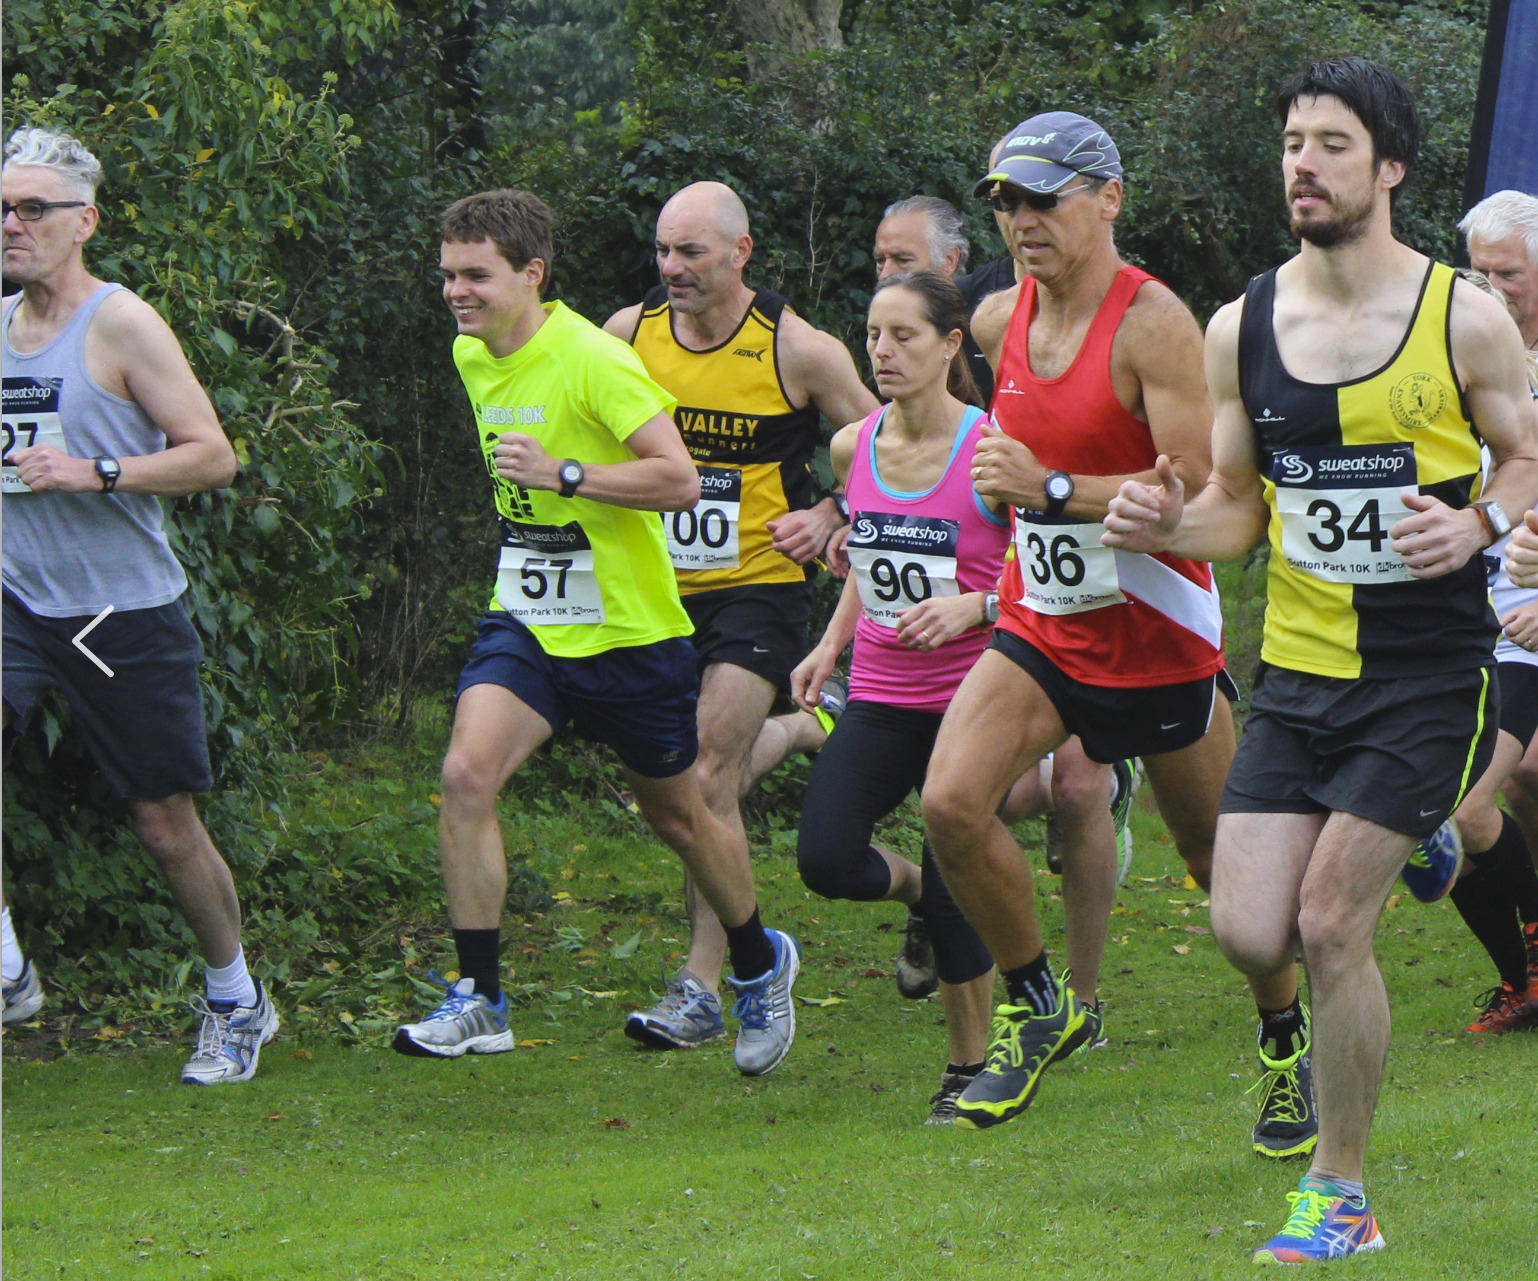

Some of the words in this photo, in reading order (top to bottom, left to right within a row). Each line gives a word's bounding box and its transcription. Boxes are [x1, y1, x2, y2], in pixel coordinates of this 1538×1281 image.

[2, 385, 51, 400] sweatshop
[481, 405, 515, 425] LEEDS
[517, 405, 548, 424] 10K
[680, 412, 759, 438] VALLEY
[1318, 454, 1405, 472] sweatshop
[700, 475, 733, 490] tshop
[661, 508, 730, 549] 00
[882, 524, 948, 544] sweatshop
[1306, 499, 1388, 553] 34
[523, 530, 577, 543] sweatshop
[1027, 532, 1086, 587] 36
[1287, 558, 1321, 571] Sutton
[1323, 561, 1347, 573] Park
[1350, 564, 1371, 573] 10K
[520, 557, 574, 600] 57
[870, 557, 932, 605] 90
[1058, 596, 1076, 605] 10K
[508, 607, 529, 616] utton
[531, 607, 551, 616] Park
[553, 607, 568, 615] 10K
